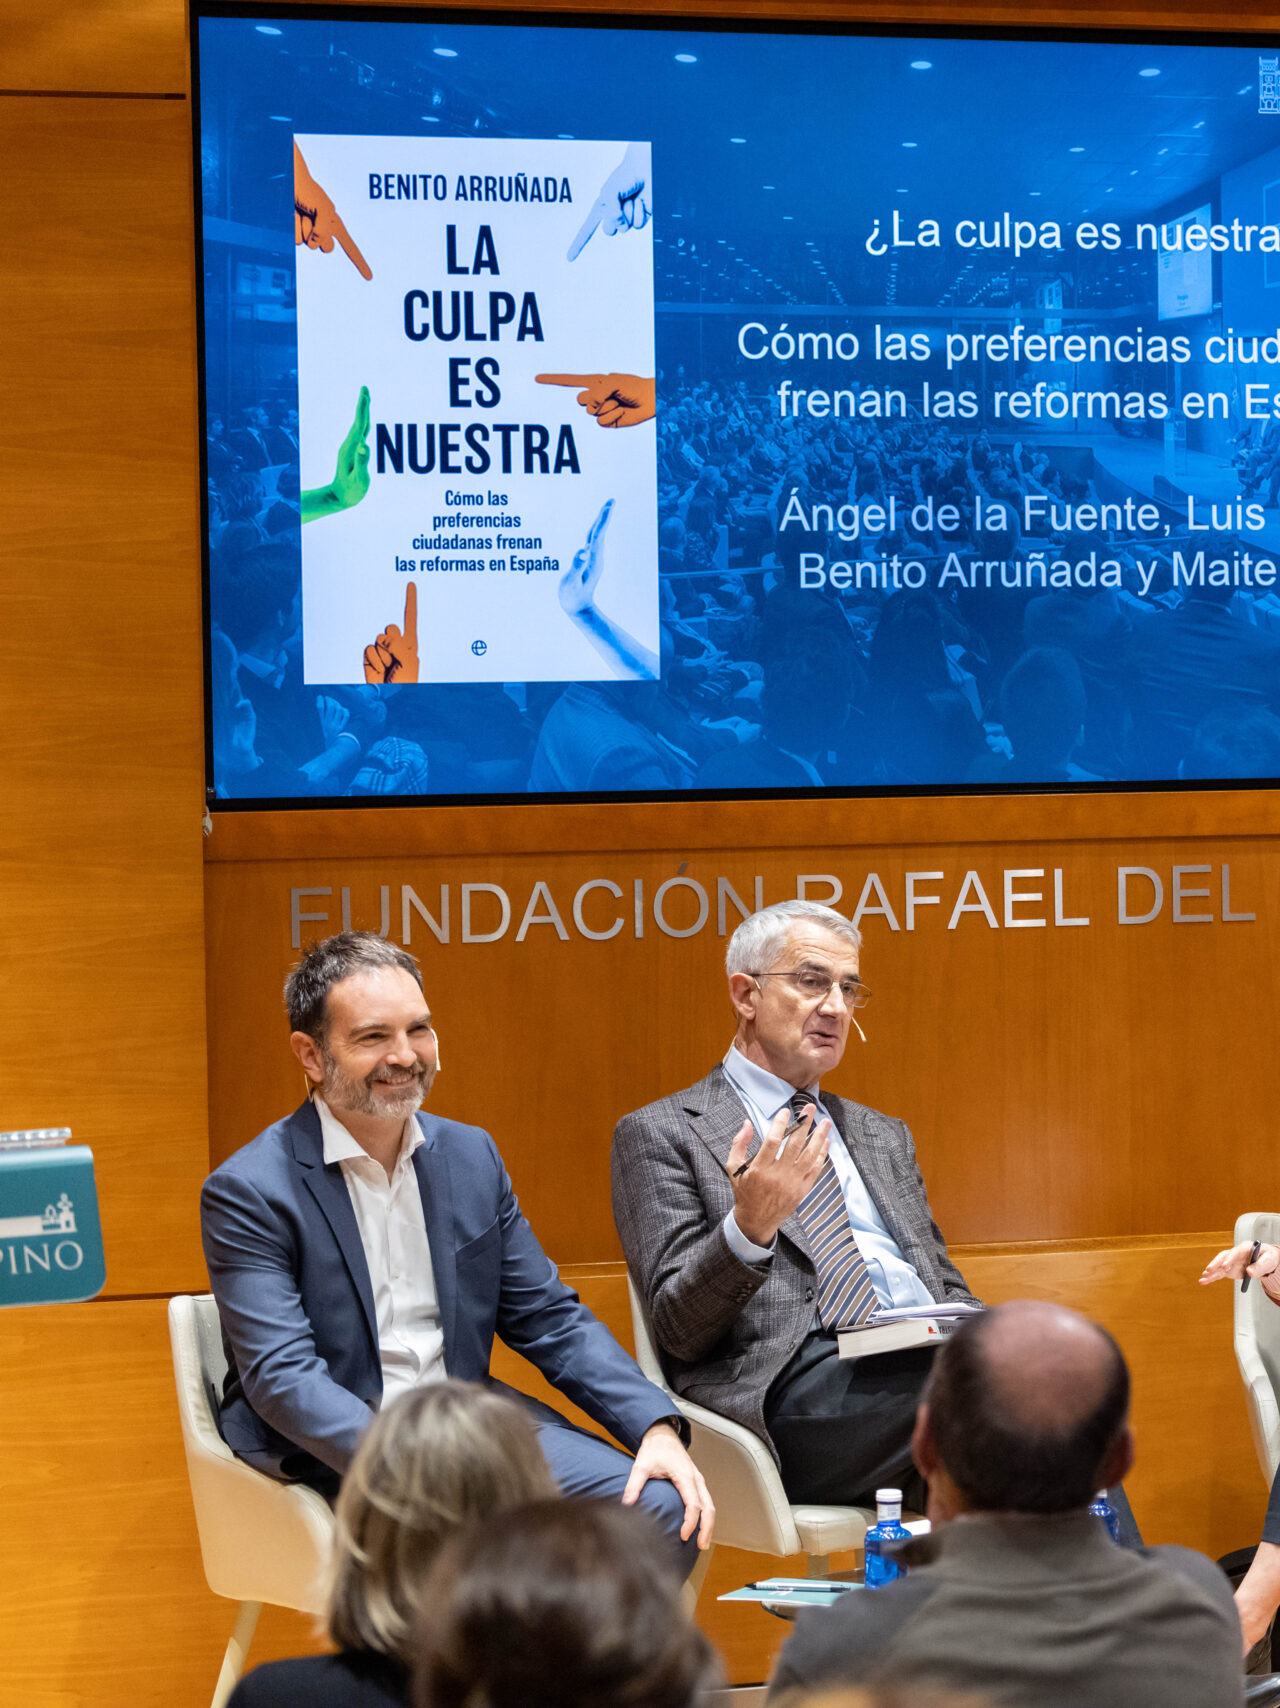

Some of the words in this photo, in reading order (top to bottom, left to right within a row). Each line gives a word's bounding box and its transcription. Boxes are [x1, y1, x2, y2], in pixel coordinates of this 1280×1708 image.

[369, 173, 447, 201] BENITO
[455, 173, 572, 203] ARRUÑADA
[446, 224, 500, 275] LA
[866, 211, 940, 255] ¿La
[956, 213, 1060, 256] culpa
[1077, 223, 1120, 249] es
[404, 289, 544, 342] CULPA
[739, 323, 858, 359] Cómo
[876, 325, 930, 360] las
[947, 326, 1190, 369] preferencias
[449, 357, 501, 408] ES
[778, 381, 905, 416] frenan
[924, 383, 977, 417] las
[995, 383, 1168, 418] reformas
[1183, 393, 1228, 418] en
[376, 423, 581, 474] NUESTRA
[445, 490, 483, 506] Cómo
[488, 490, 508, 505] las
[780, 488, 894, 540] Ángel
[913, 497, 958, 530] de
[977, 496, 1006, 530] la
[1026, 496, 1169, 536] Fuente,
[1189, 496, 1264, 530] Luis
[413, 534, 492, 549] ciudadanas
[496, 534, 542, 549] frenan
[433, 512, 521, 531] preferencias
[396, 556, 416, 571] las
[420, 556, 485, 571] reformas
[489, 560, 506, 571] en
[510, 555, 559, 574] España
[801, 554, 925, 588] Benito
[940, 552, 1121, 586] Arruñada
[1137, 562, 1156, 595] y
[1174, 552, 1275, 585] Maite
[290, 862, 763, 948] FUNDACIÓN
[796, 868, 1090, 932] RAFAEL
[1118, 864, 1256, 924] DEL
